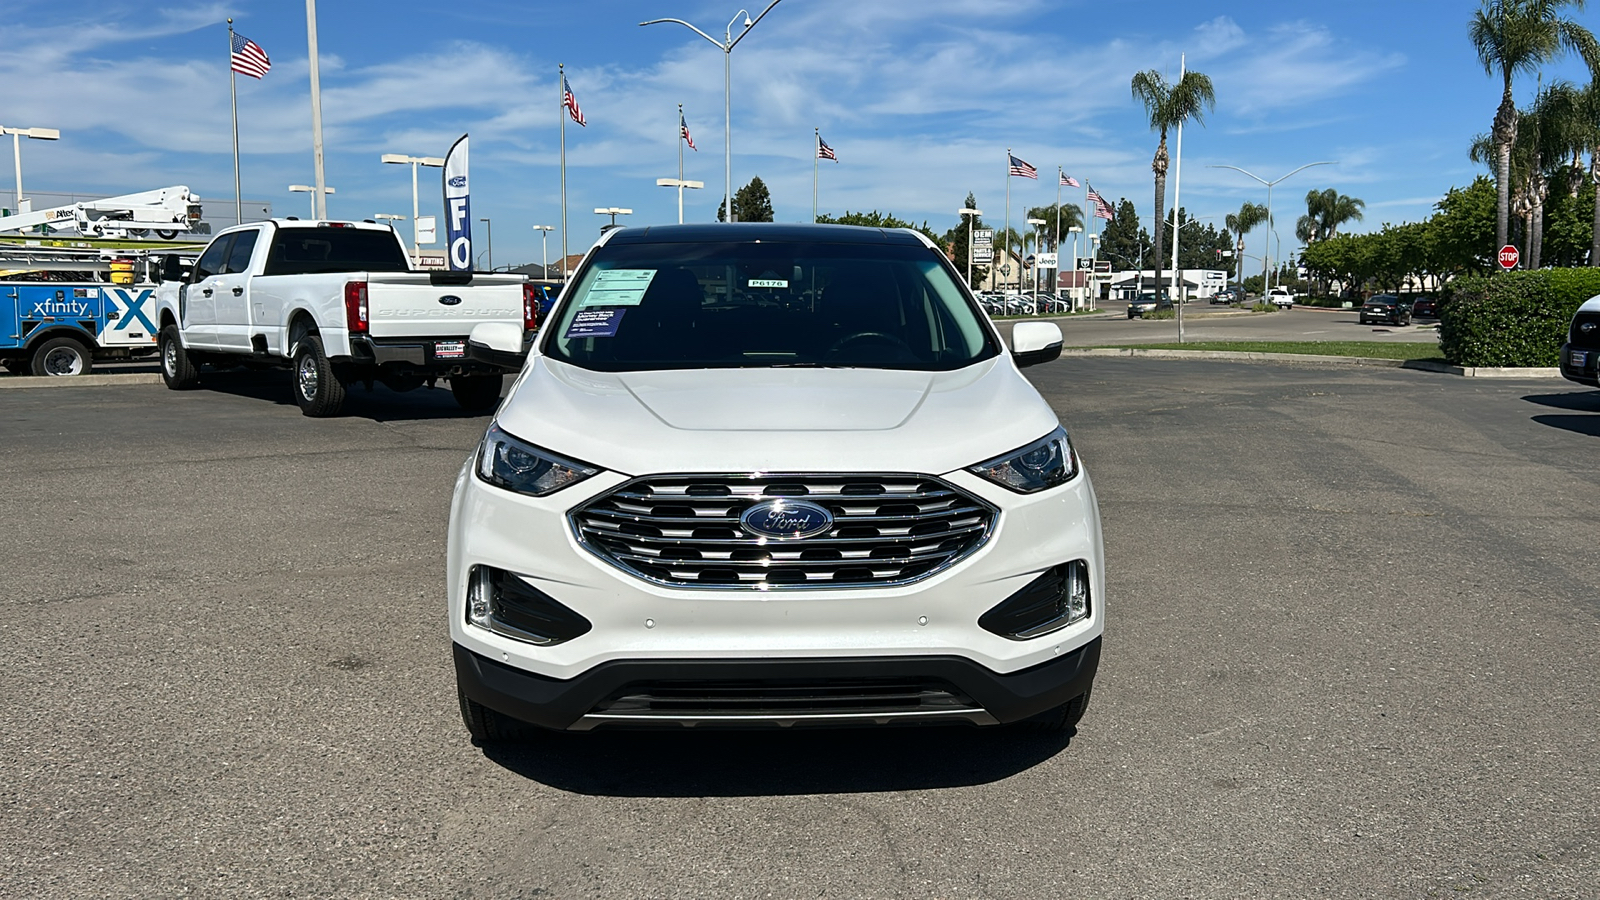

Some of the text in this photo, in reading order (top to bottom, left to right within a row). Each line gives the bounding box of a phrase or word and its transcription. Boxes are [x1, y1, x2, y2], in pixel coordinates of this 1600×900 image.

[56, 209, 74, 219] Altec
[450, 198, 470, 269] FO
[422, 257, 444, 265] TINTING
[1500, 252, 1517, 261] STOP
[33, 298, 88, 316] xfinity
[379, 308, 517, 317] SUPER DUTY
[763, 509, 811, 530] Ford
